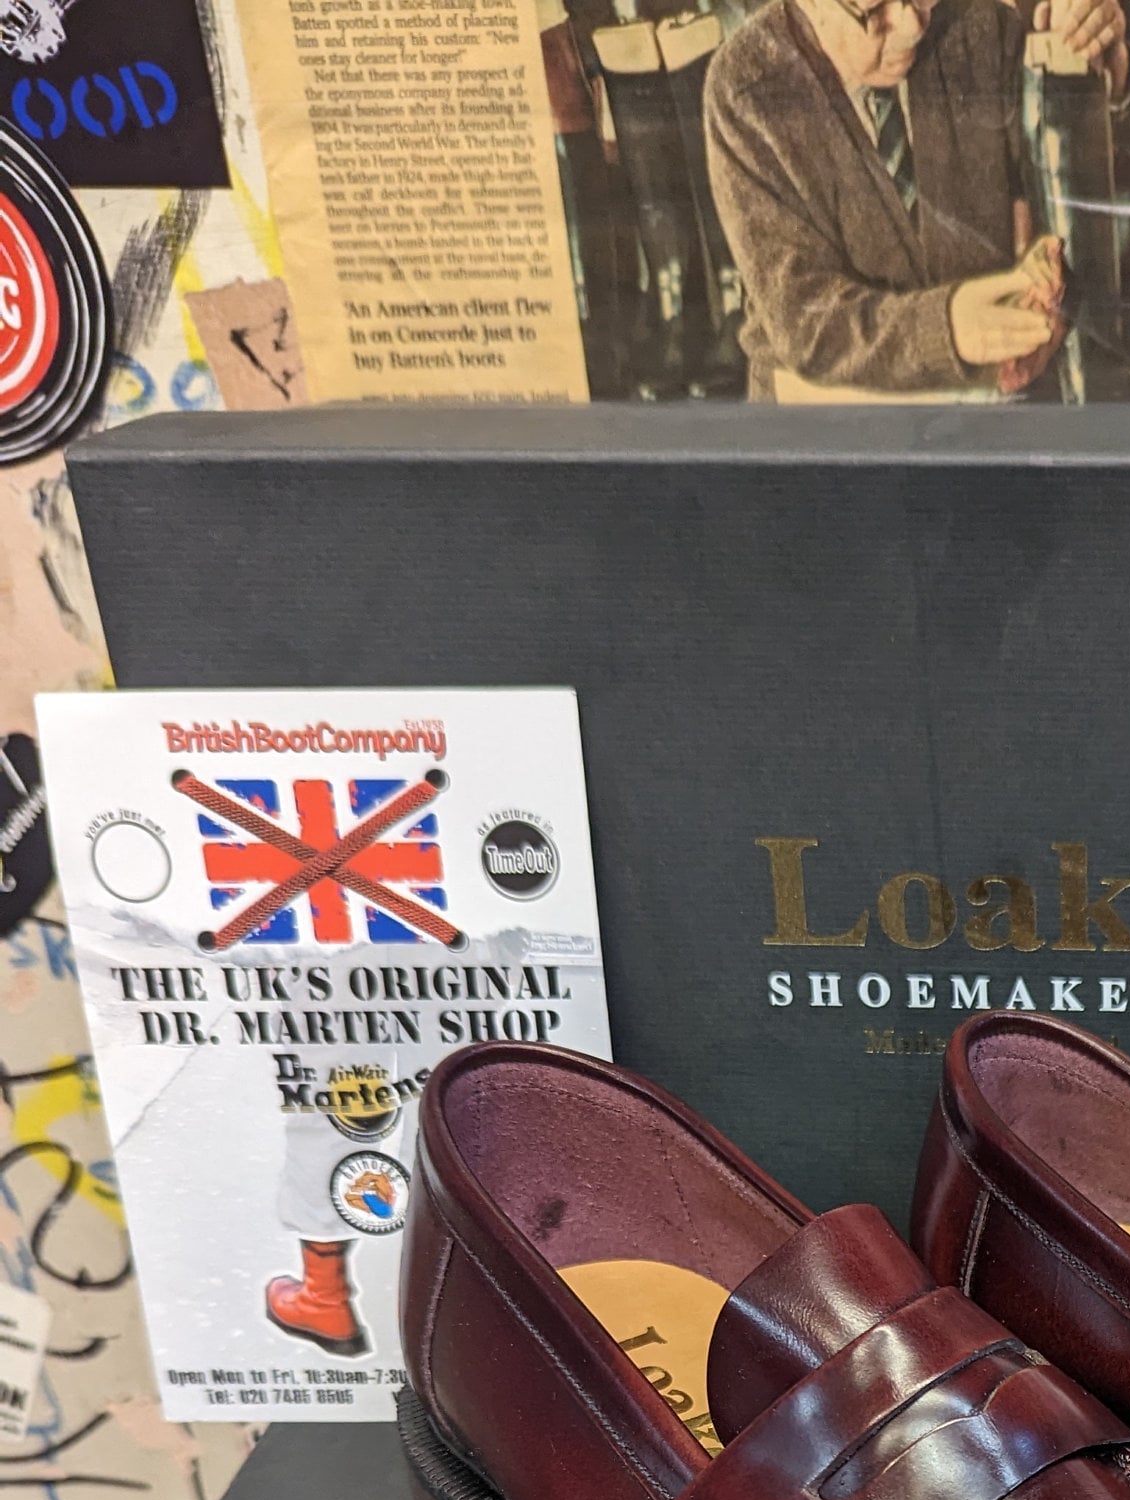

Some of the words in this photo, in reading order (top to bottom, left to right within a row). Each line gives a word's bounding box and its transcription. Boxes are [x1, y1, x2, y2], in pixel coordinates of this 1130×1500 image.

[336, 15, 379, 34] spotted
[383, 18, 391, 29] a
[395, 15, 441, 29] method
[446, 15, 459, 28] of
[463, 14, 518, 32] placating
[296, 34, 318, 48] him
[325, 34, 346, 48] and
[352, 33, 405, 50] retaining
[411, 33, 428, 46] his
[299, 53, 326, 67] ones
[329, 52, 351, 69] stay
[355, 52, 398, 66] cleaner
[402, 51, 417, 64] for
[314, 69, 336, 83] Not
[341, 69, 364, 83] that
[369, 69, 399, 82] there
[404, 69, 427, 81] was
[457, 67, 508, 84] prospect
[513, 65, 526, 79] of
[376, 300, 460, 319] American
[464, 298, 511, 316] client
[371, 328, 393, 344] on
[397, 325, 479, 345] Concorde
[519, 325, 538, 343] to
[353, 351, 384, 373] buy
[459, 350, 506, 368] boots
[111, 966, 208, 1002] THE
[224, 965, 334, 1002] UK'S
[350, 965, 572, 1002] ORIGINAL
[140, 1011, 221, 1046] DR.
[235, 1010, 421, 1046] MARTEN
[441, 1010, 562, 1044] SHOP
[168, 1369, 207, 1386] Open
[212, 1369, 245, 1385] Mon
[251, 1370, 267, 1385] to
